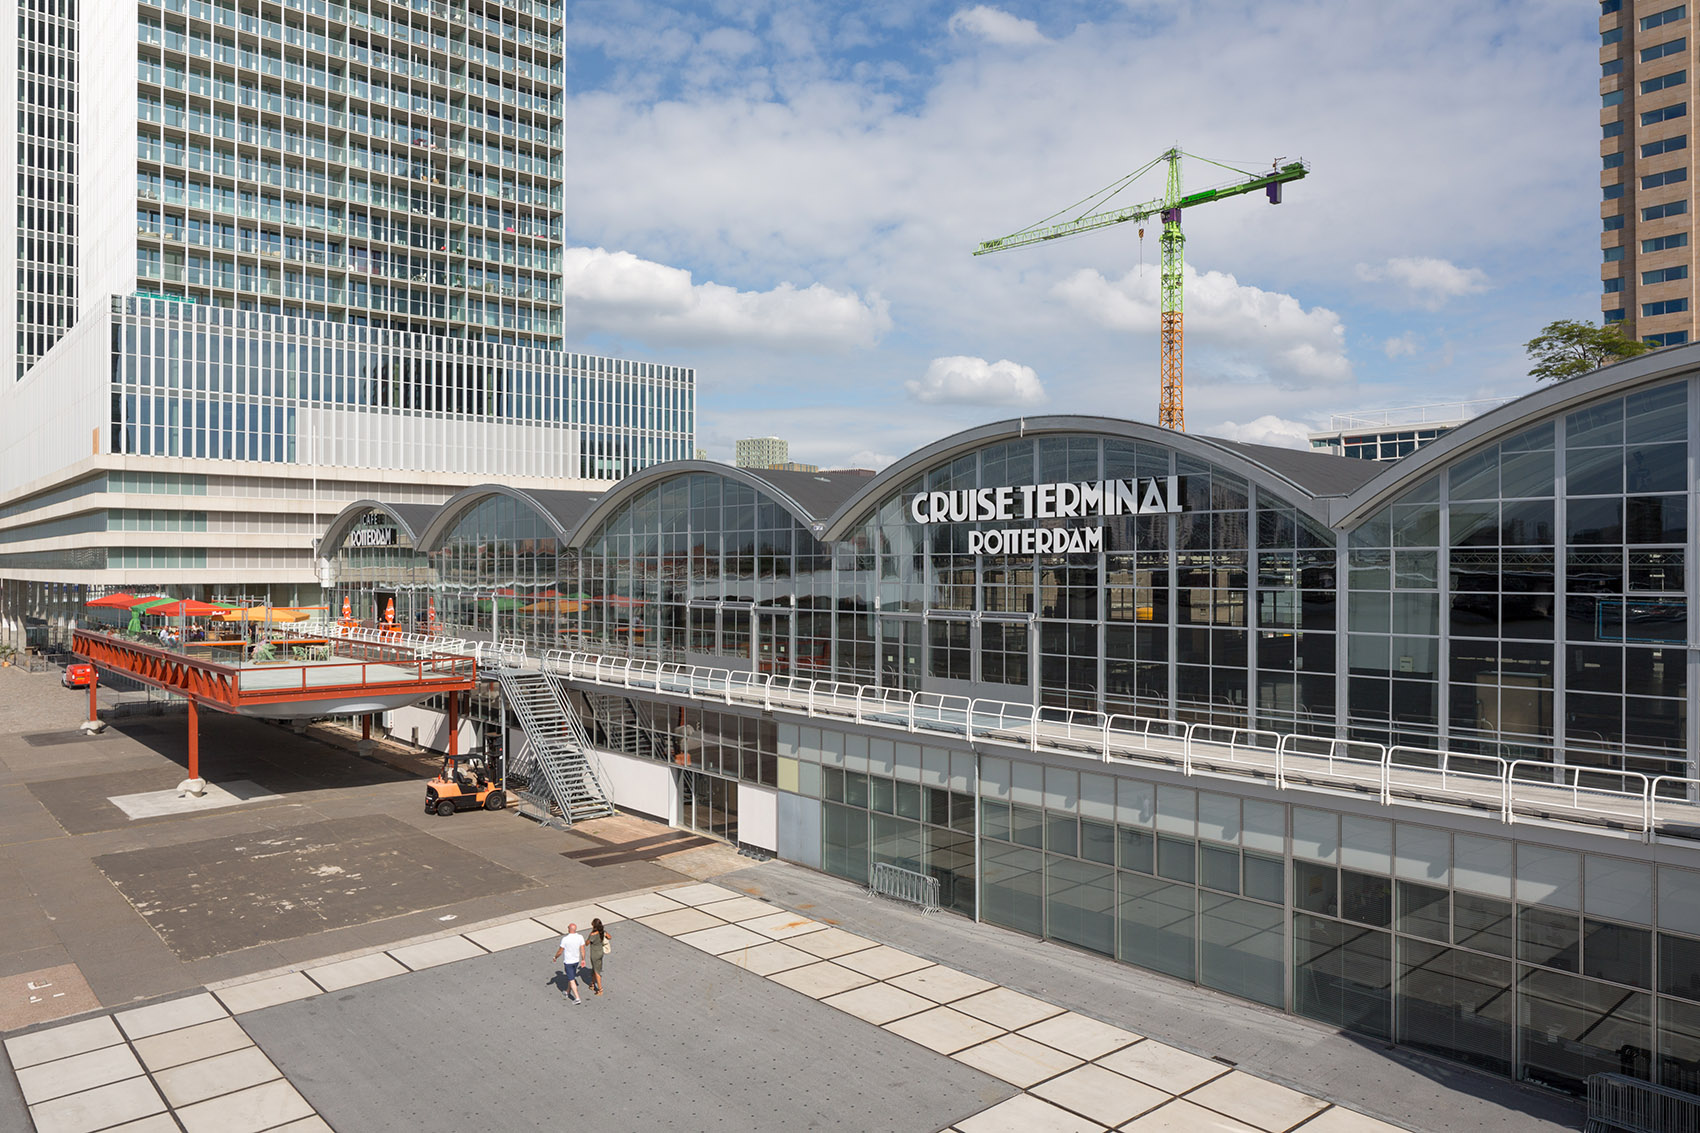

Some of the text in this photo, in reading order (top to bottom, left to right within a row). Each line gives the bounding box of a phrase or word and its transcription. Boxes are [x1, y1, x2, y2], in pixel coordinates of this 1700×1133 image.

[911, 475, 1182, 524] CRUISE TERMINAL
[351, 528, 391, 546] ROTTERDAM
[968, 526, 1103, 555] ROTTERDAM
